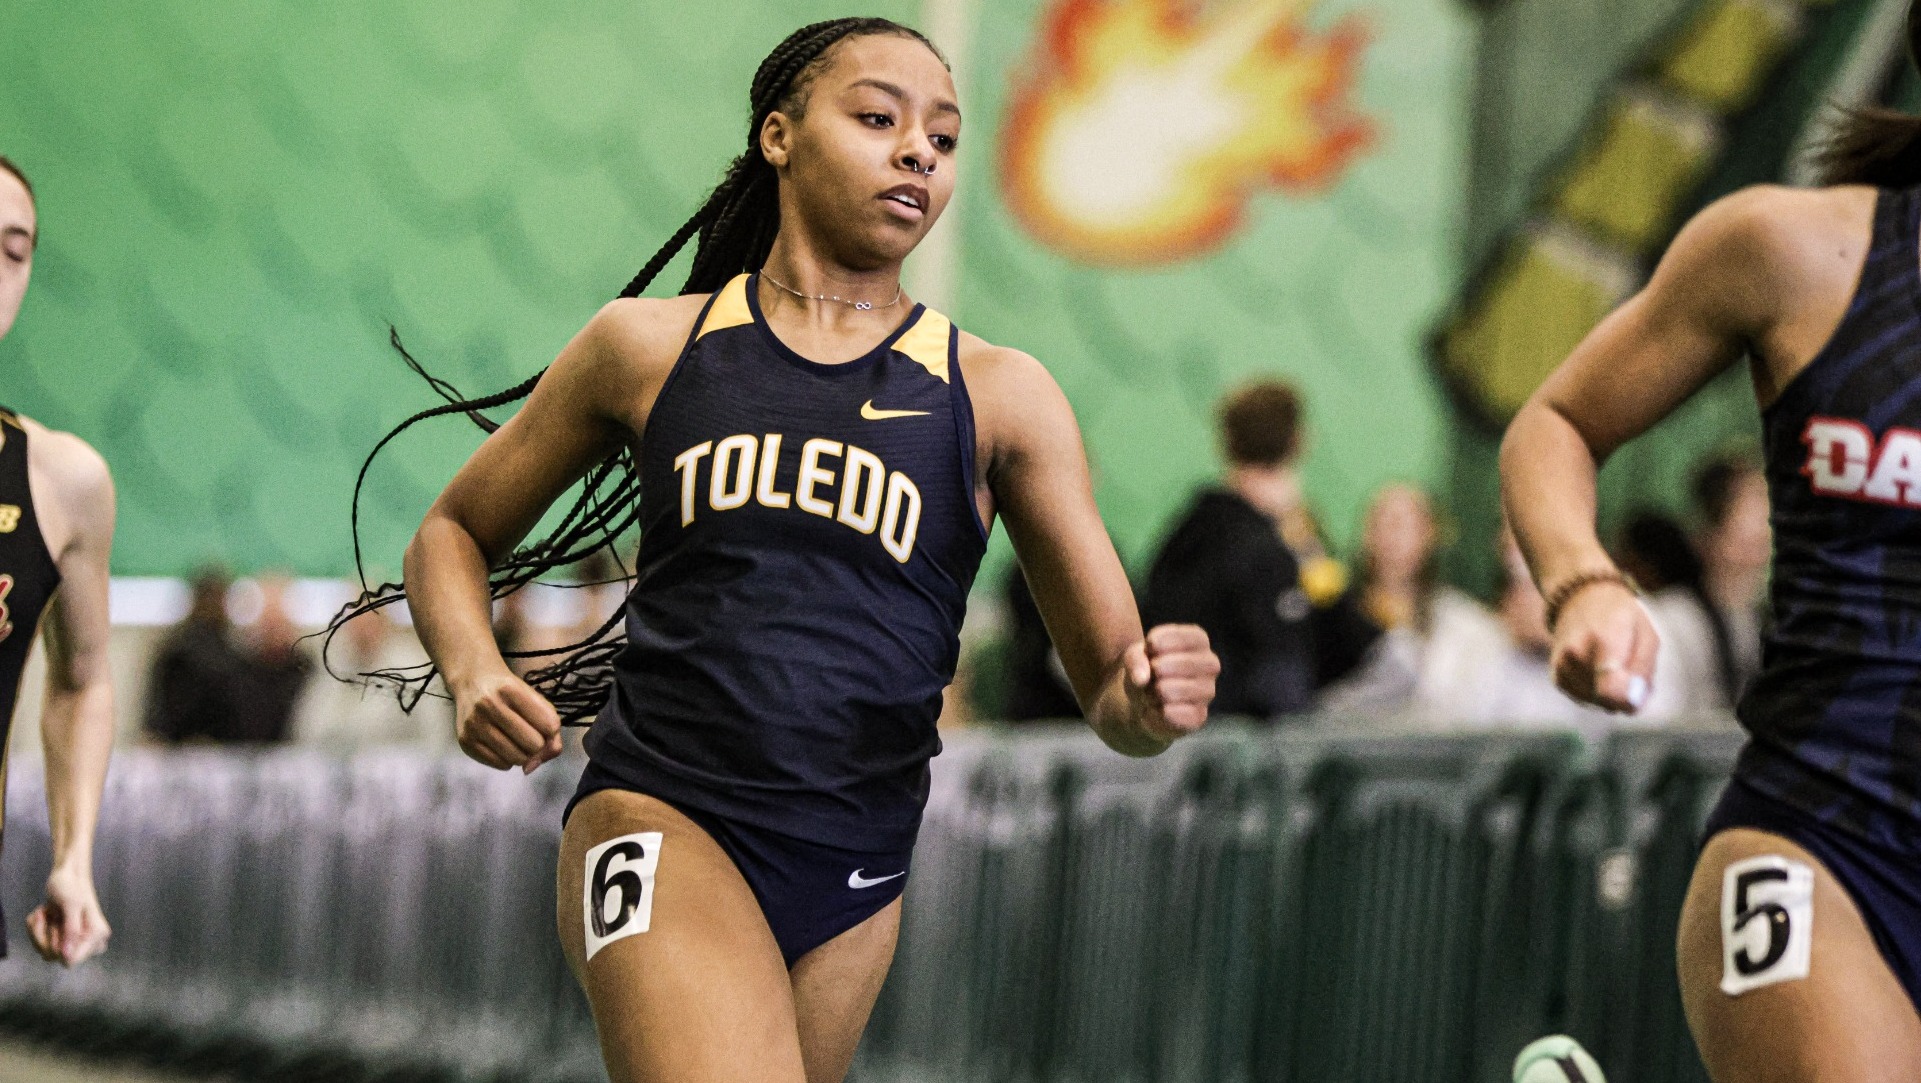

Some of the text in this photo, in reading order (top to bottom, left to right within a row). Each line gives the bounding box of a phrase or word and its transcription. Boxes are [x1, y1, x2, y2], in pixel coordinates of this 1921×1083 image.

[673, 433, 922, 563] TOLEDO
[591, 841, 645, 938] 6
[1734, 868, 1790, 976] 5
